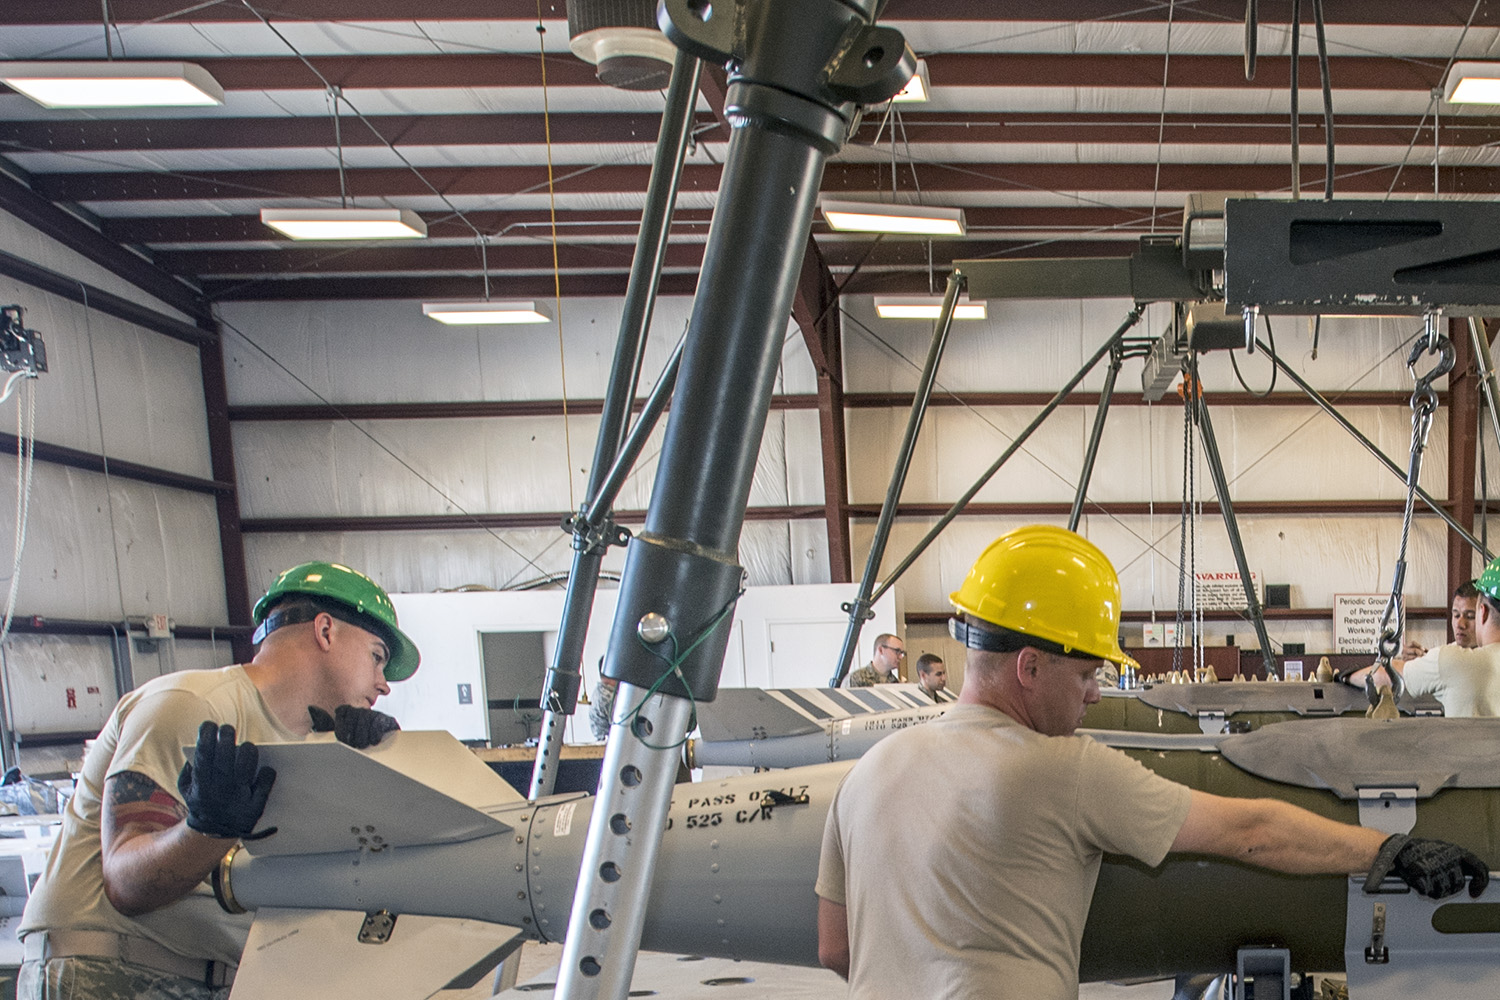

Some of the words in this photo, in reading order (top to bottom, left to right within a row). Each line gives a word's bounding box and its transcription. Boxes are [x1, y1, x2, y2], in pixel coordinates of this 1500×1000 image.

[1195, 572, 1257, 581] WARNIG
[1339, 597, 1366, 606] Periodic
[1349, 608, 1357, 616] of
[1343, 617, 1375, 626] Required
[1347, 627, 1376, 636] Working
[1338, 637, 1374, 646] Electrically
[1340, 647, 1372, 655] Explosive
[688, 793, 736, 809] PASS
[686, 812, 722, 829] 525
